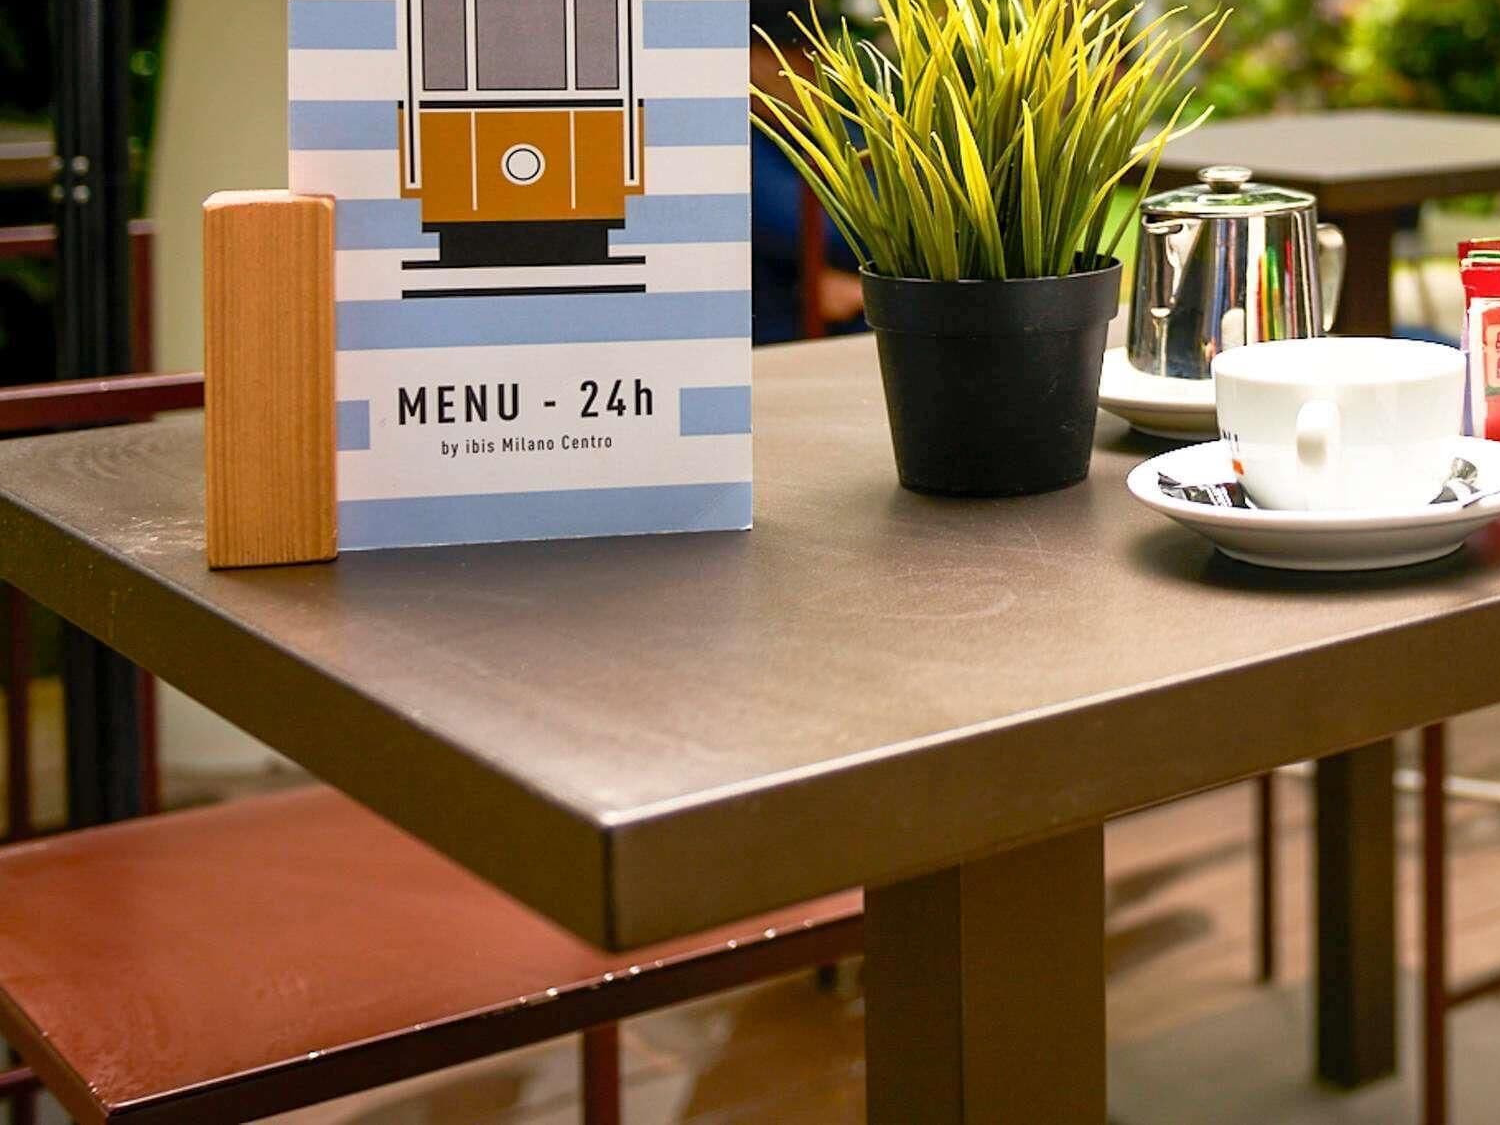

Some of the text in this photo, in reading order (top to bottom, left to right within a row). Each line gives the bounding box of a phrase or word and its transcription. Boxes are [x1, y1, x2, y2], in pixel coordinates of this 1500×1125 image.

[397, 381, 521, 427] MENU
[579, 377, 654, 420] 24h
[440, 433, 613, 460] by ibis Milano Centro
